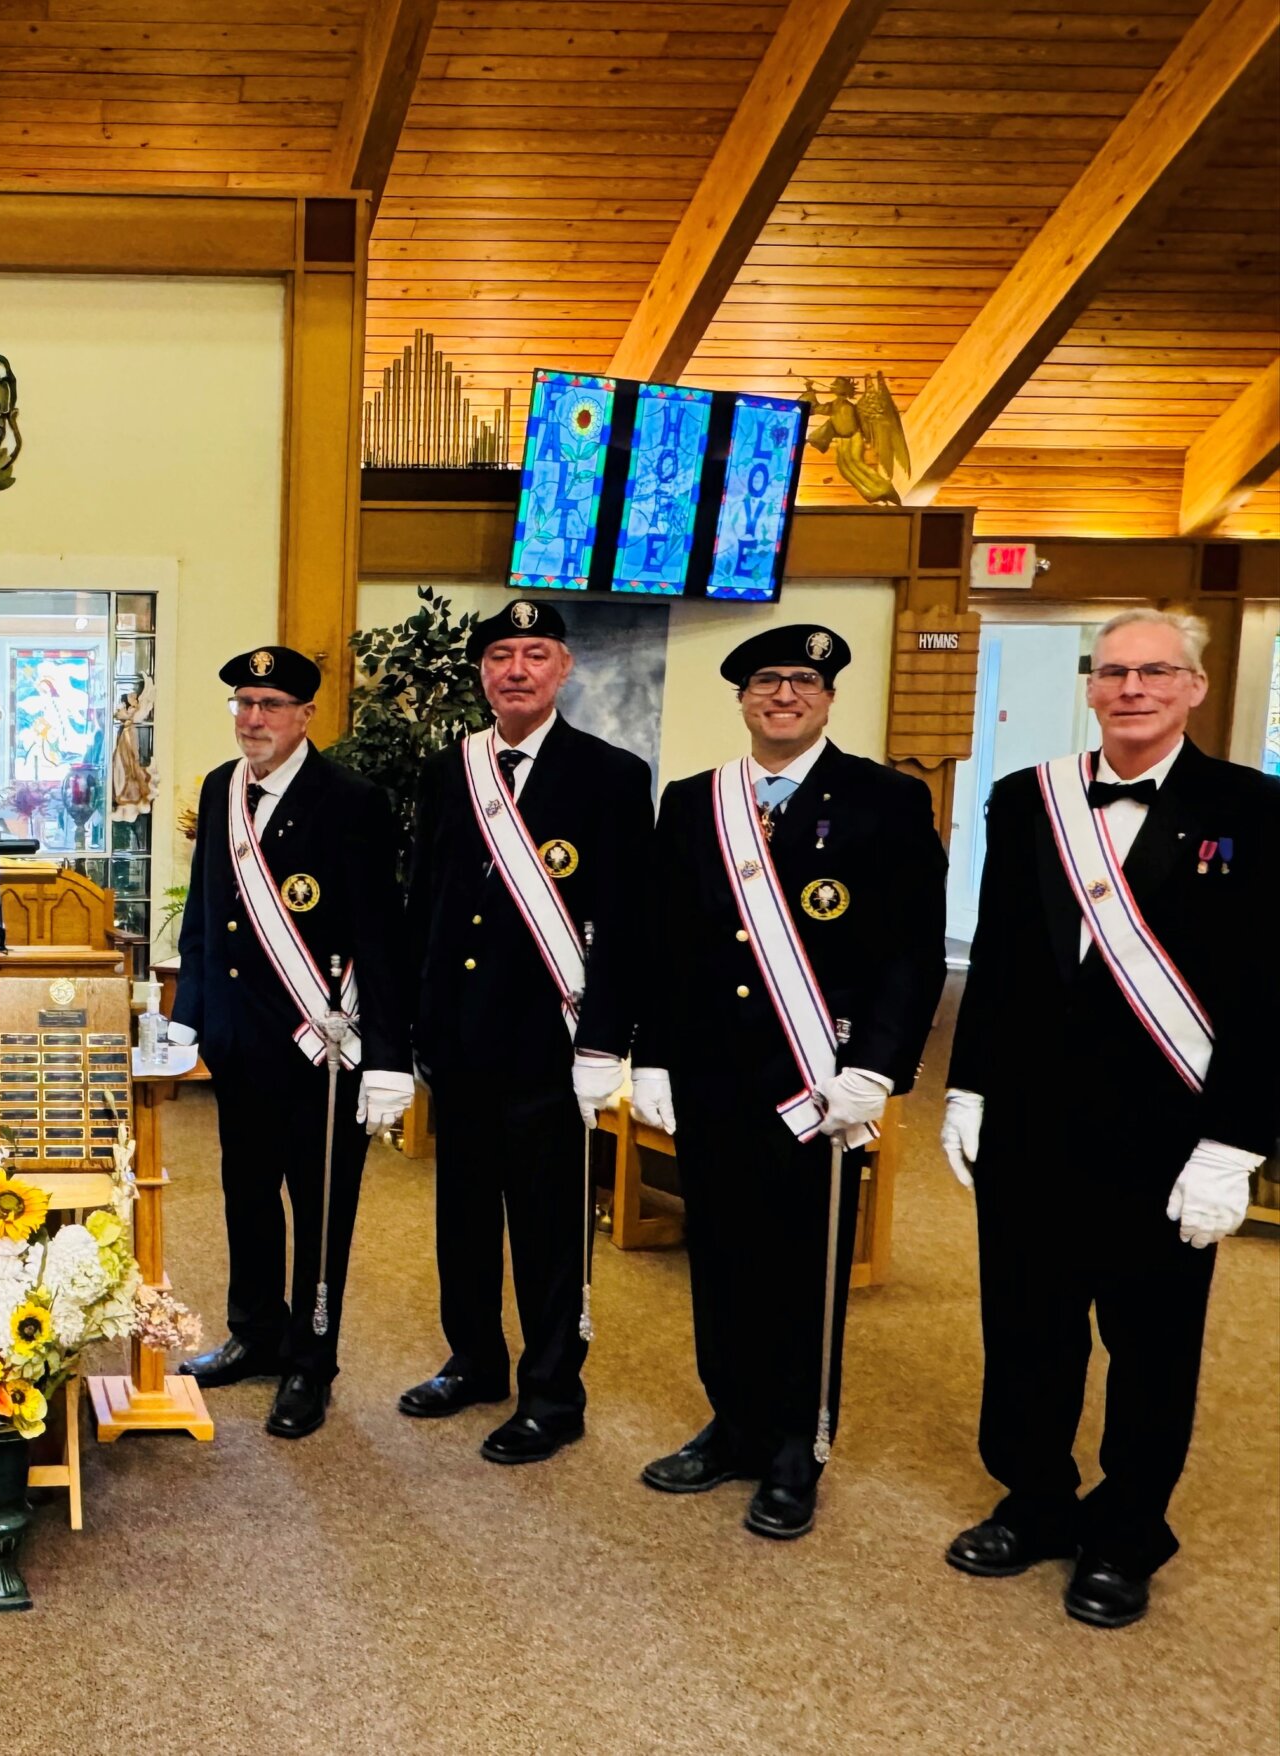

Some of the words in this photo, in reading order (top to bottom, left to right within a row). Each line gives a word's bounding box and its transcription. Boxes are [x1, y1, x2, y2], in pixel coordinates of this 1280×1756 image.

[734, 421, 773, 576] LOVE
[988, 547, 1026, 575] EXIT
[919, 633, 958, 649] HYMNS
